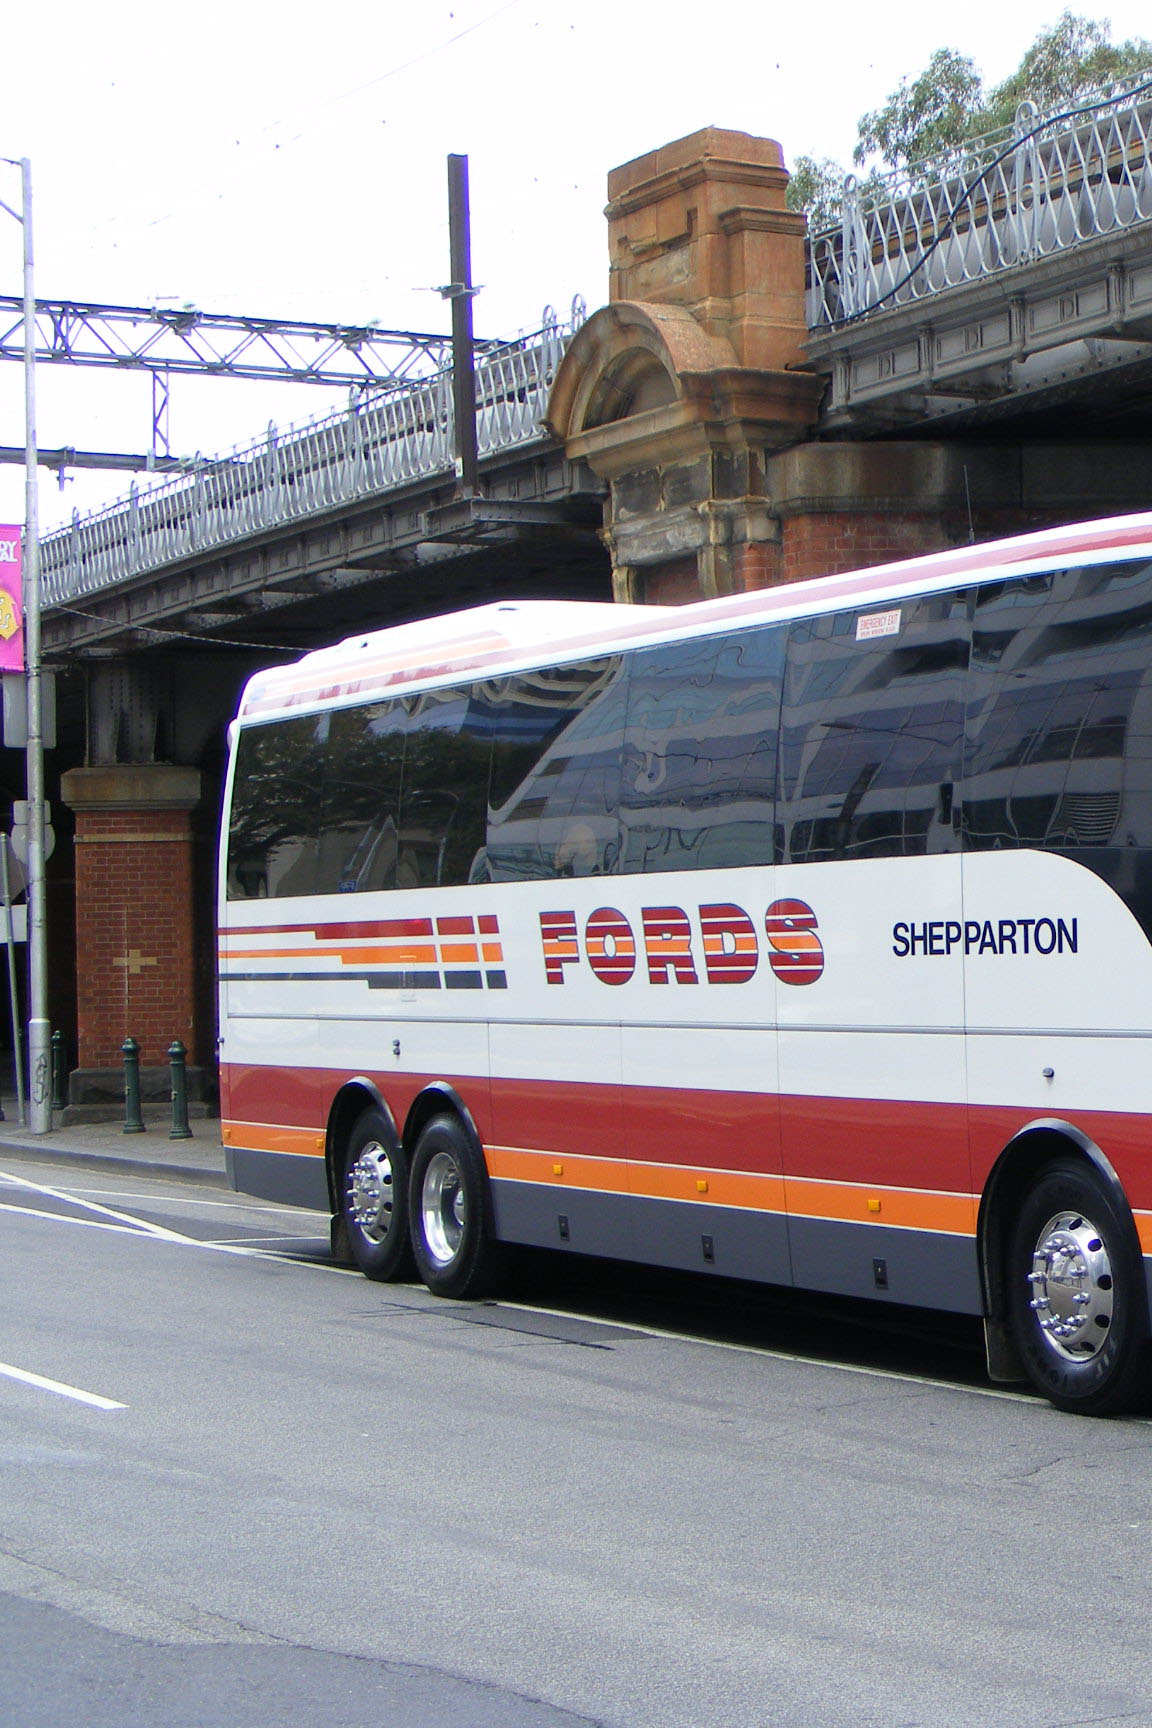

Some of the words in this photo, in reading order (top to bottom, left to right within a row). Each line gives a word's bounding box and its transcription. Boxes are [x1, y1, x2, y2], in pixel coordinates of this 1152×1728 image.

[860, 615, 887, 631] EMERGENCY
[887, 613, 898, 626] EXIT
[539, 897, 825, 987] FORDS
[892, 917, 1078, 957] SHEPPARTON
